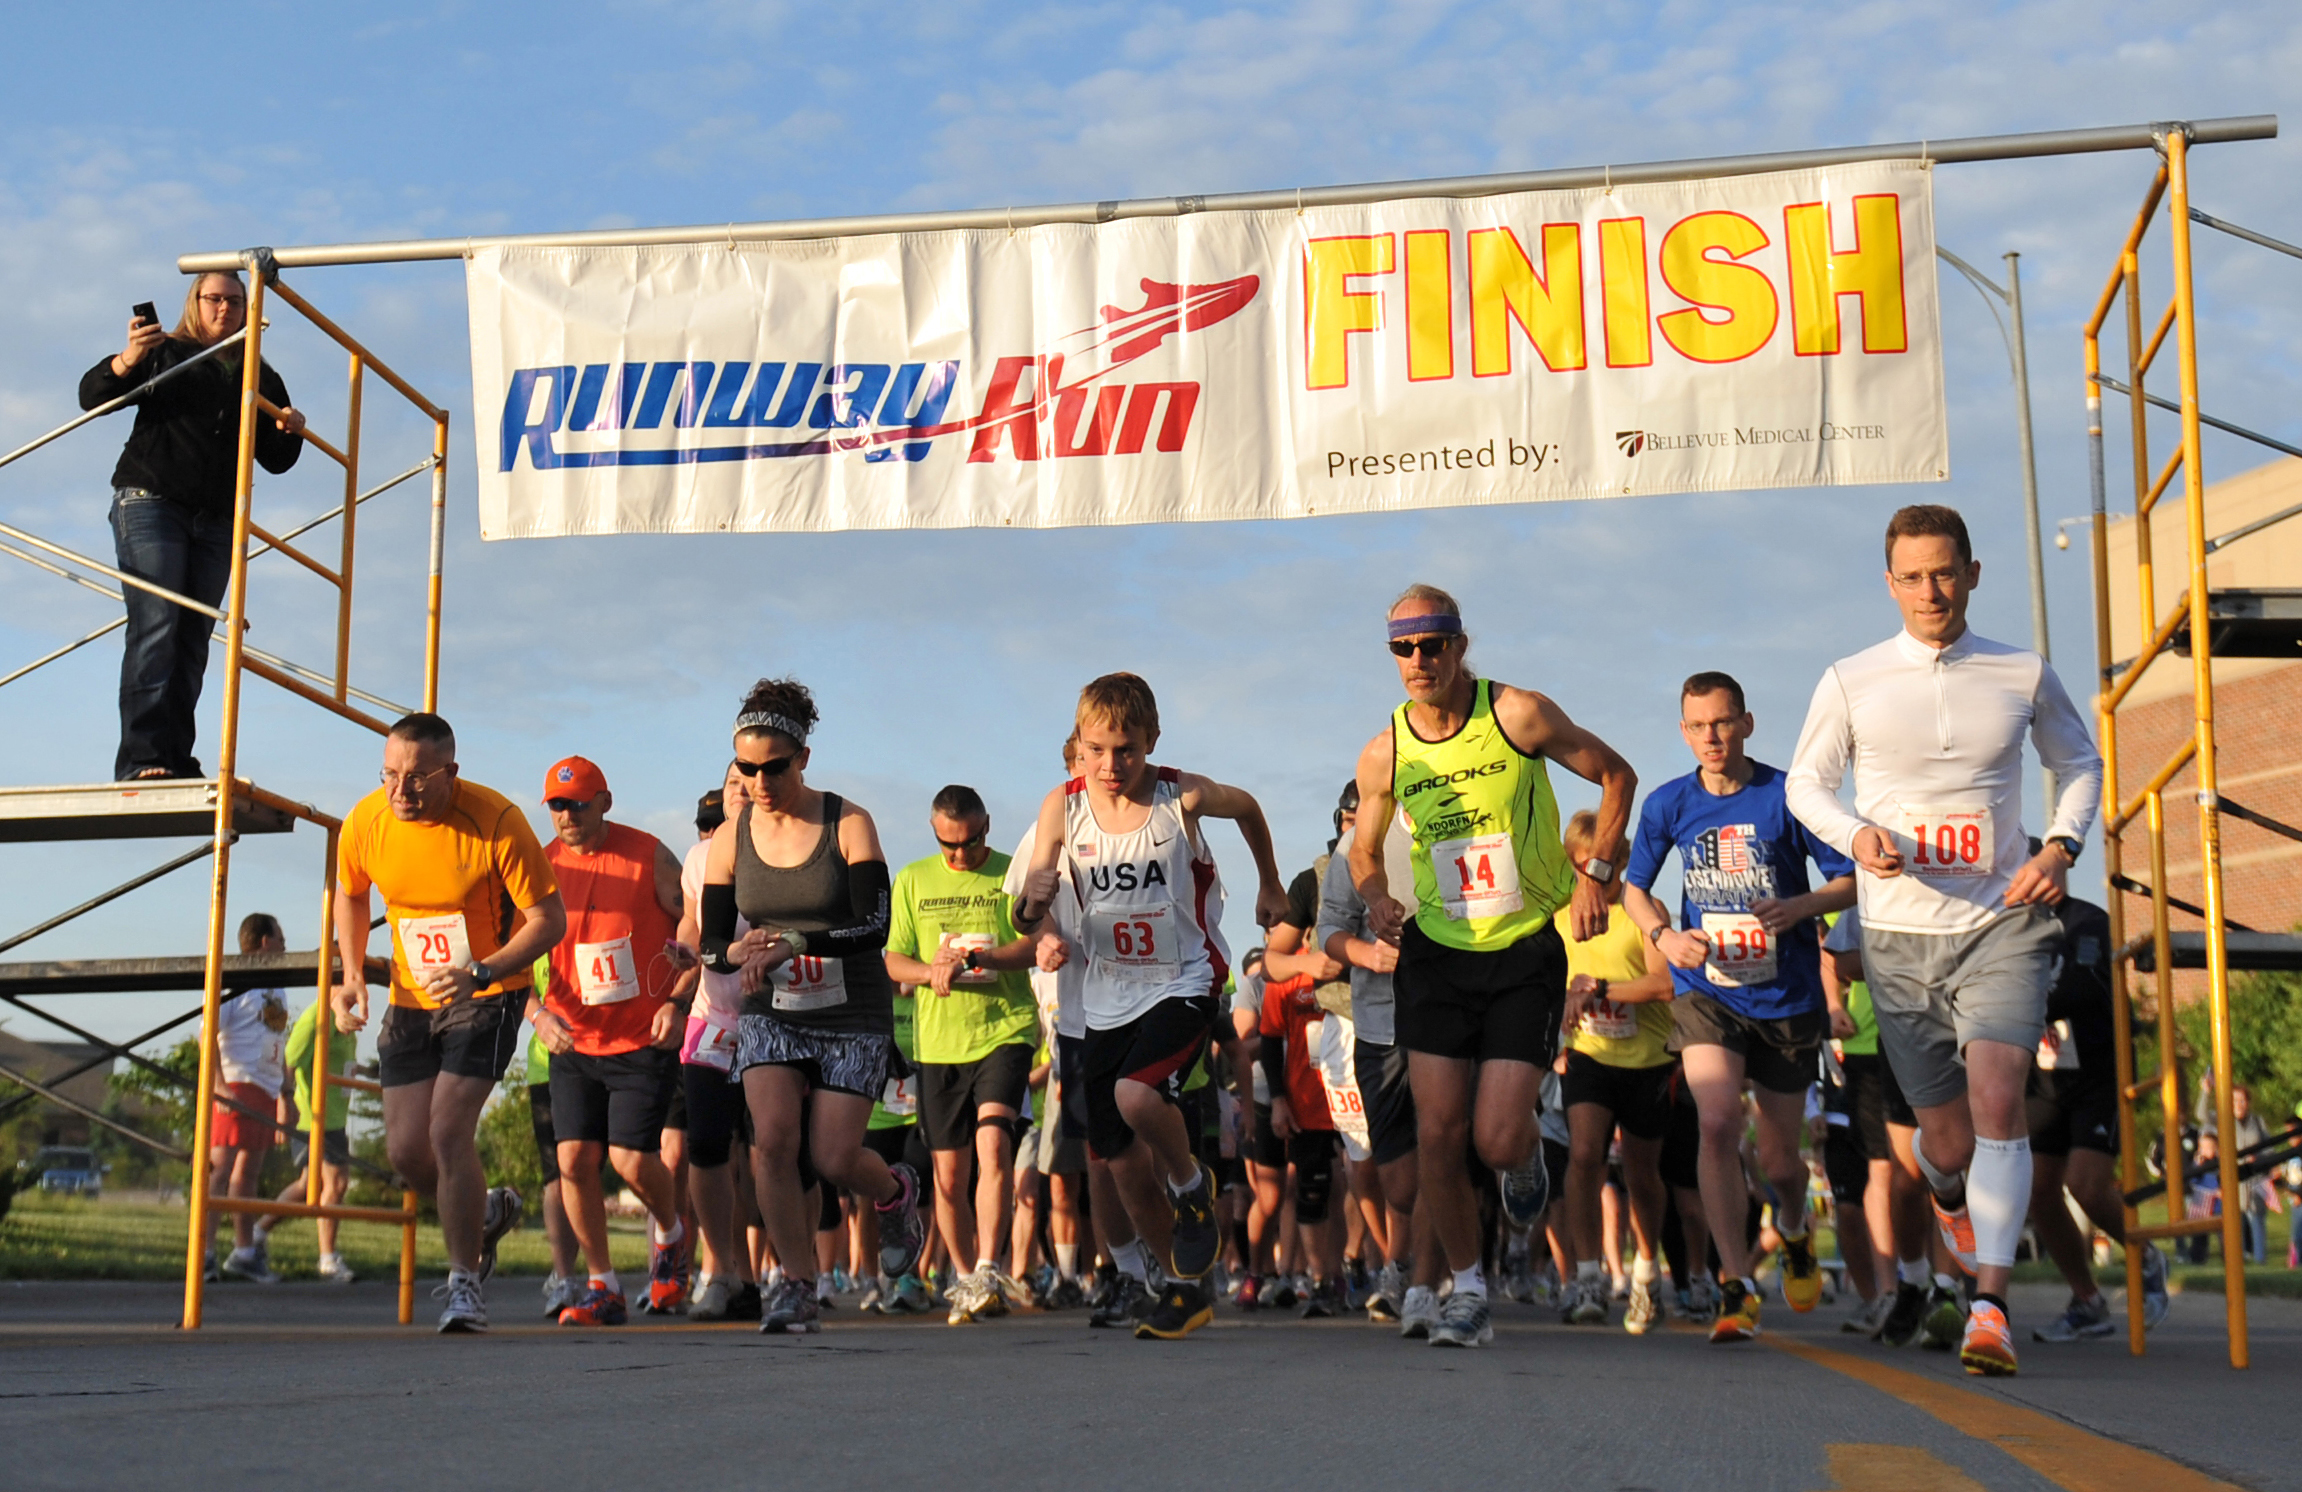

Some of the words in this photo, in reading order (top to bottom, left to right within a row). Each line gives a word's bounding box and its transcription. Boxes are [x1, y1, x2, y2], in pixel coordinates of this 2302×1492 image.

[1303, 193, 1907, 390] FINISH
[500, 359, 960, 472] Runway
[967, 352, 1200, 465] Run
[1328, 438, 1495, 478] Presented
[1509, 437, 1559, 472] by:
[1404, 759, 1507, 797] BROOKS
[1913, 824, 1980, 865] 108
[1090, 859, 1167, 891] USA
[1454, 854, 1495, 891] 14
[972, 894, 999, 908] Run
[416, 933, 451, 963] 29
[1113, 921, 1155, 957] 63
[1714, 928, 1767, 961] 139
[592, 954, 619, 983] 41
[788, 955, 824, 987] 30
[1327, 1088, 1362, 1113] 138
